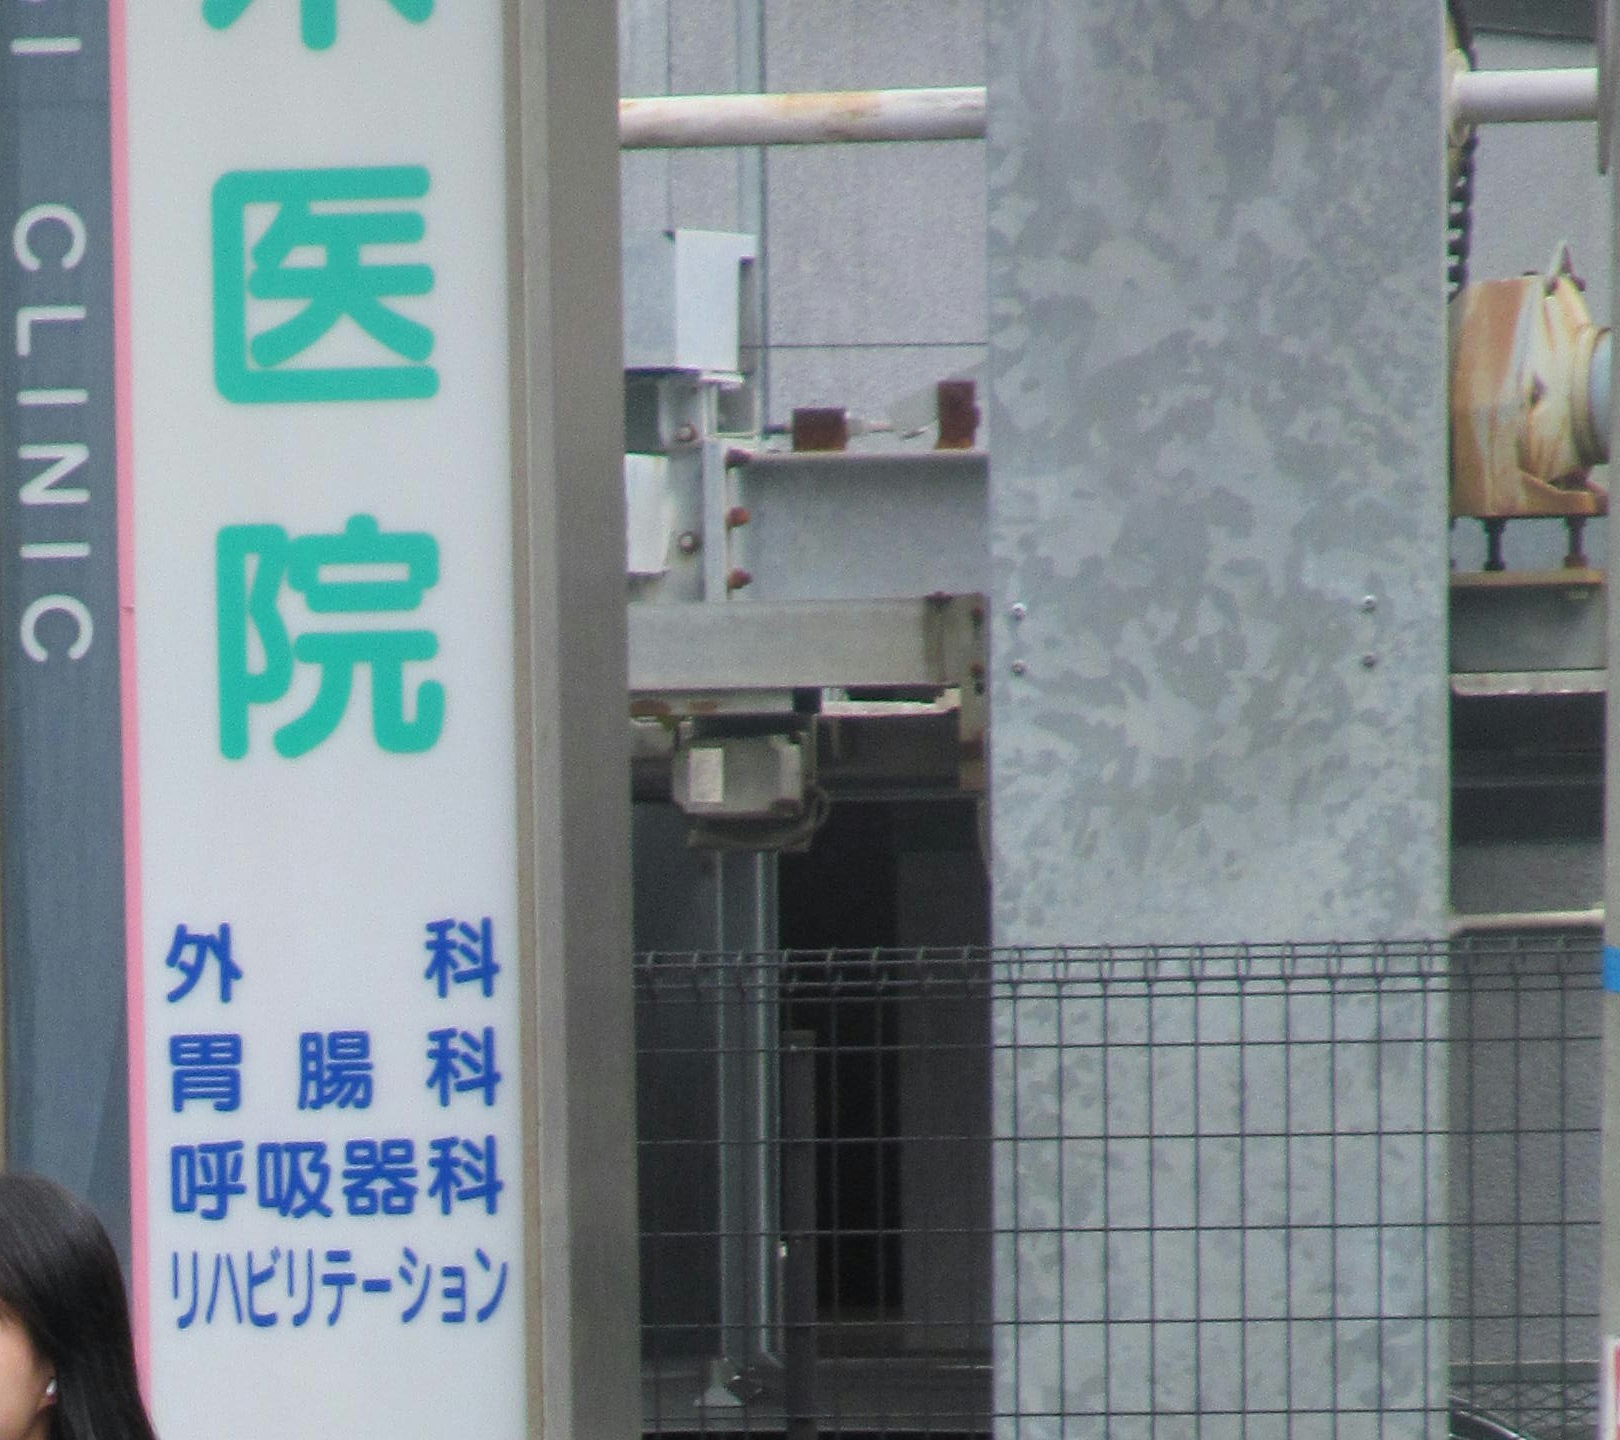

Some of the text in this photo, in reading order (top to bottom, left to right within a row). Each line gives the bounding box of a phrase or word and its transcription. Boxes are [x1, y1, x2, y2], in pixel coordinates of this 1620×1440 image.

[202, 0, 446, 761] 医院
[12, 203, 94, 662] CLINIC
[168, 1026, 503, 1114] 胃腸科
[169, 1134, 504, 1221] 呼吸器科
[171, 1247, 509, 1330] リハビリテーション
